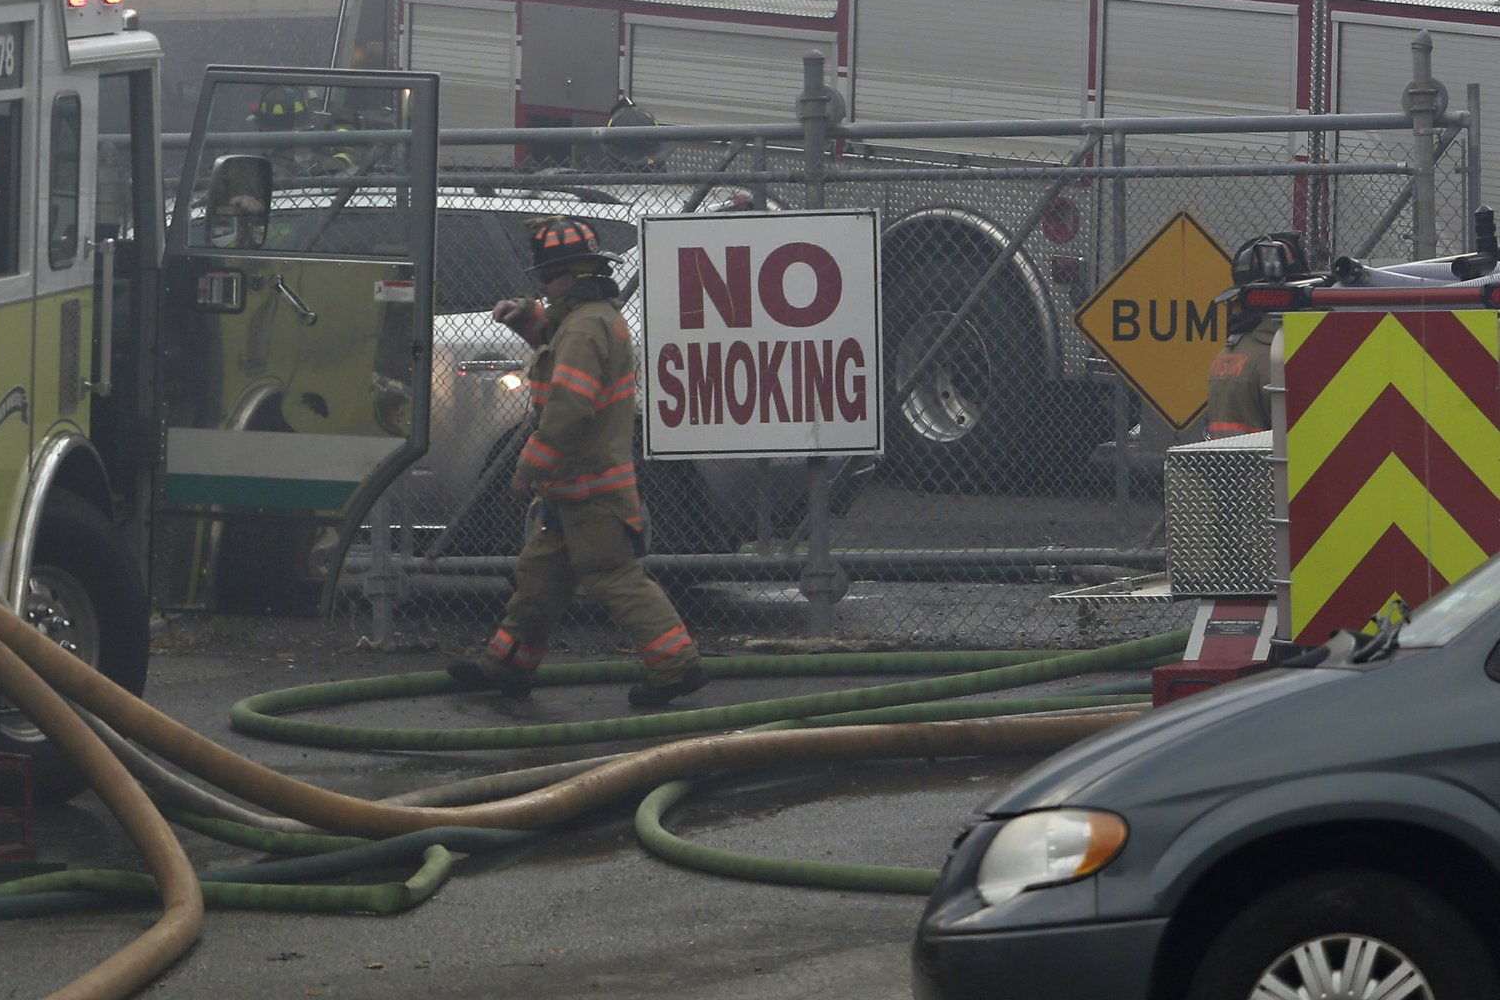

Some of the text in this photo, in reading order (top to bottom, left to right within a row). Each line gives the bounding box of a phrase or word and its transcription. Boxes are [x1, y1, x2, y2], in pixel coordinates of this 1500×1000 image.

[677, 241, 844, 330] NO
[1112, 298, 1231, 342] BUM
[656, 336, 868, 430] SMOKING
